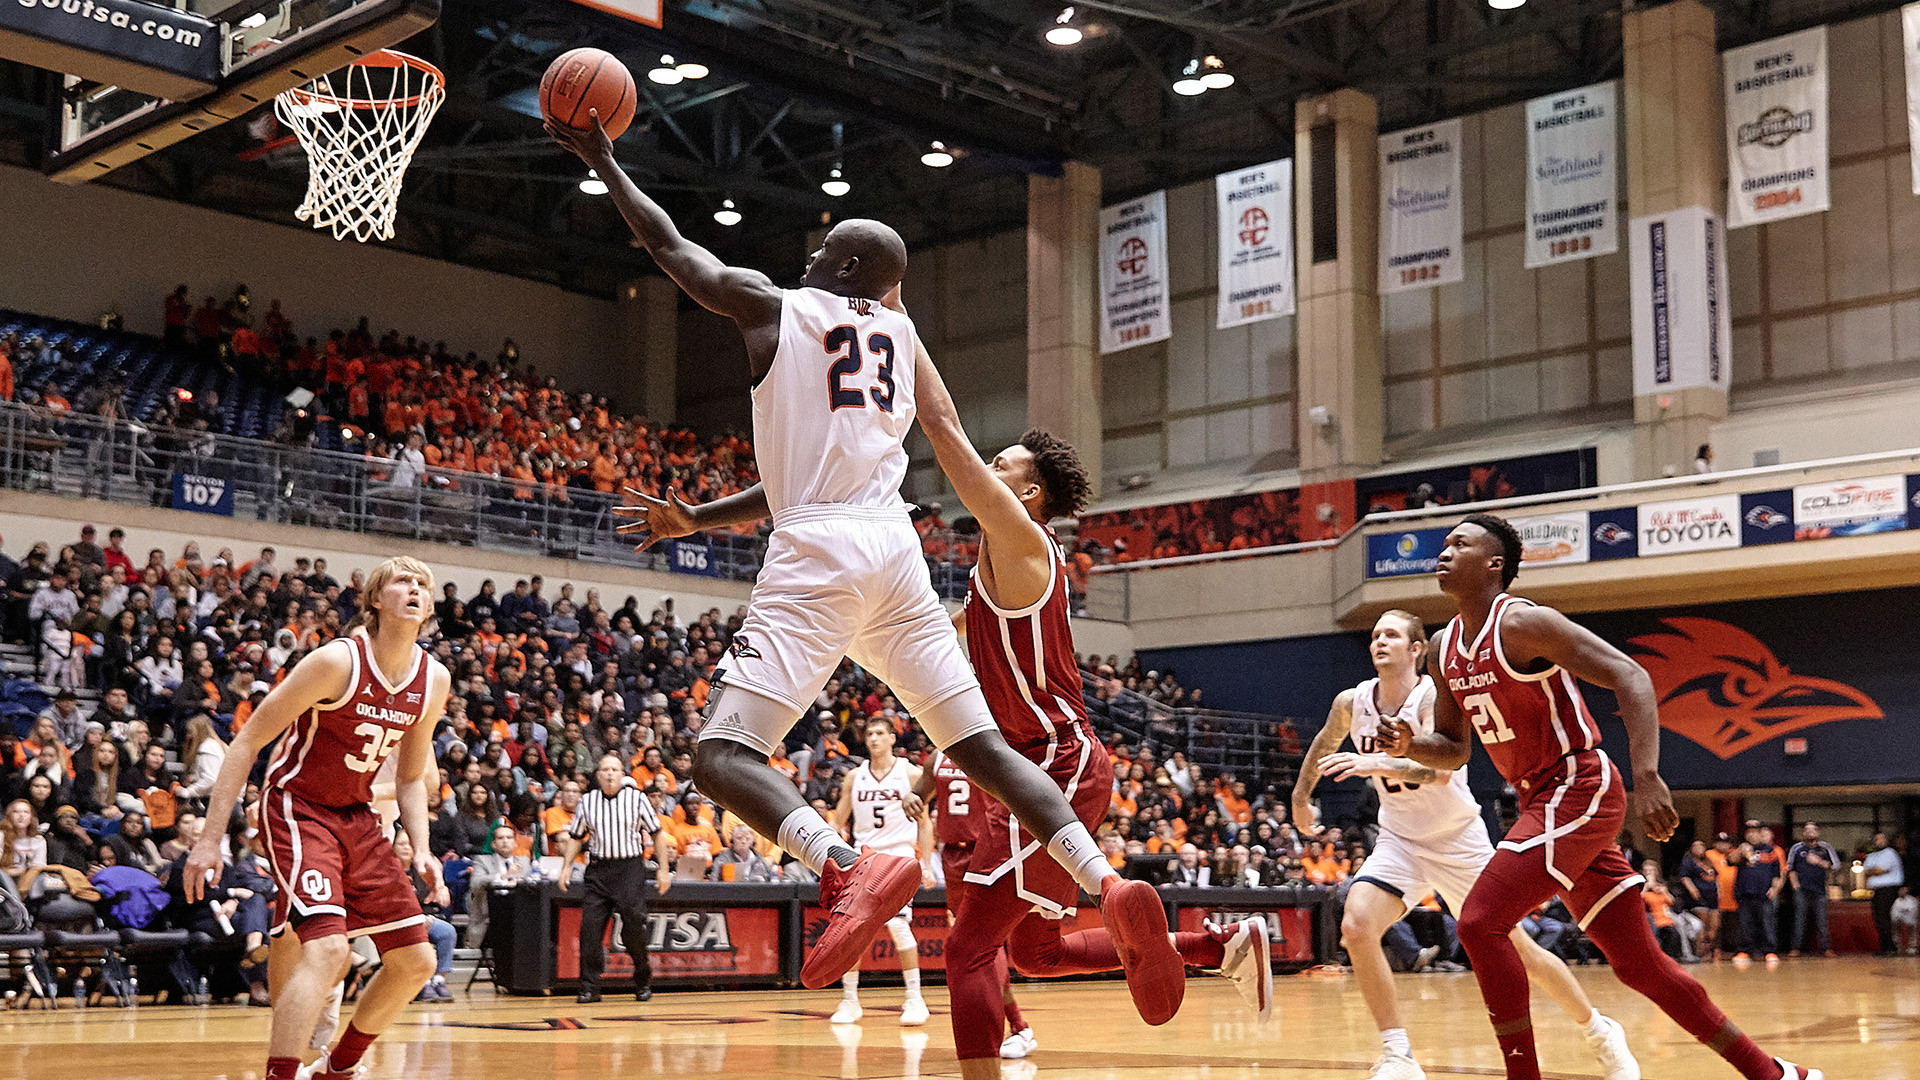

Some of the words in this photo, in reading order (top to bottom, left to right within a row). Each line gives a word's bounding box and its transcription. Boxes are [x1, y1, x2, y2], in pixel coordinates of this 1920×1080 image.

[1735, 64, 1816, 93] BASKETBALL
[1535, 106, 1605, 131] BASKETBALL
[1387, 141, 1451, 164] BASKETBALL
[1741, 166, 1815, 192] CHAMPIONS
[1227, 182, 1281, 203] BASKETBALL
[1532, 200, 1608, 225] TOURNAMENT
[1536, 218, 1603, 241] CHAMPIONS
[1388, 247, 1450, 267] CHAMPIONS
[823, 323, 896, 415] 23
[183, 484, 225, 507] 107
[1643, 521, 1735, 546] TOYOTA
[677, 549, 709, 571] 106
[1462, 691, 1517, 745] 21
[344, 721, 406, 773] 35
[858, 788, 903, 802] UTSA
[948, 779, 971, 816] 2
[873, 805, 886, 829] 5
[301, 869, 333, 902] OU
